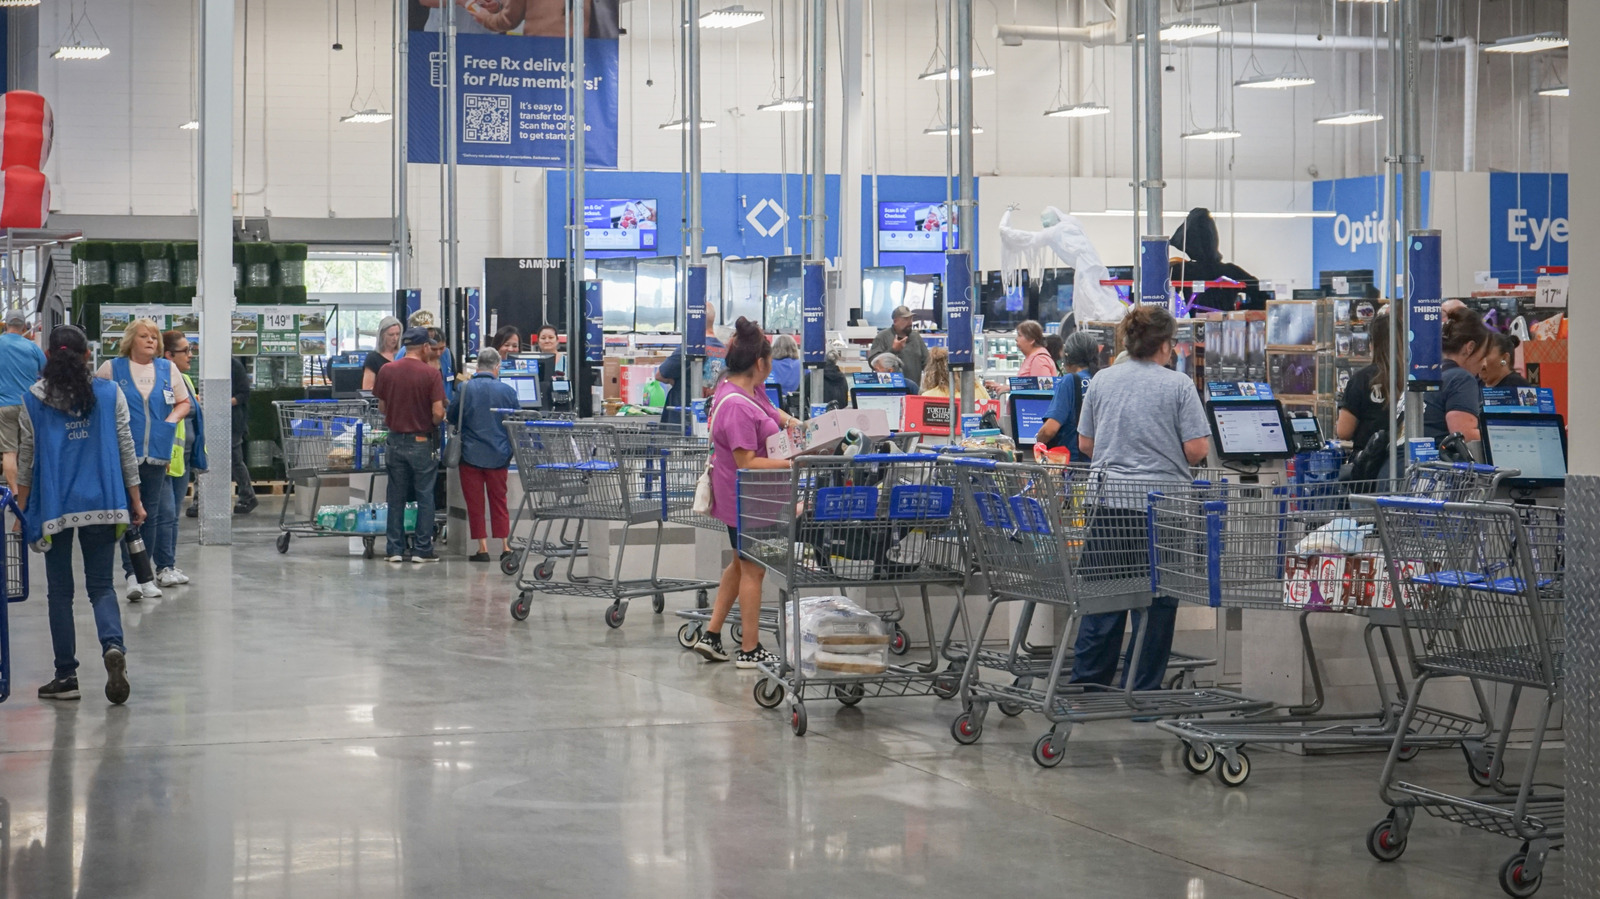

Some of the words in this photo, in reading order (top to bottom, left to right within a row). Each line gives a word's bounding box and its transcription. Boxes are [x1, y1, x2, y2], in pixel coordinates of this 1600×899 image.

[464, 55, 498, 69] Free
[501, 56, 520, 70] Rx
[523, 58, 586, 72] deliver
[463, 72, 486, 86] for
[488, 73, 520, 87] Plus
[522, 76, 602, 90] membs!
[534, 104, 552, 112] easy
[520, 112, 552, 120] transfer
[553, 114, 575, 122] tody
[520, 122, 540, 130] Scan
[541, 122, 555, 130] the
[530, 132, 544, 140] get
[65, 420, 90, 430] sam's
